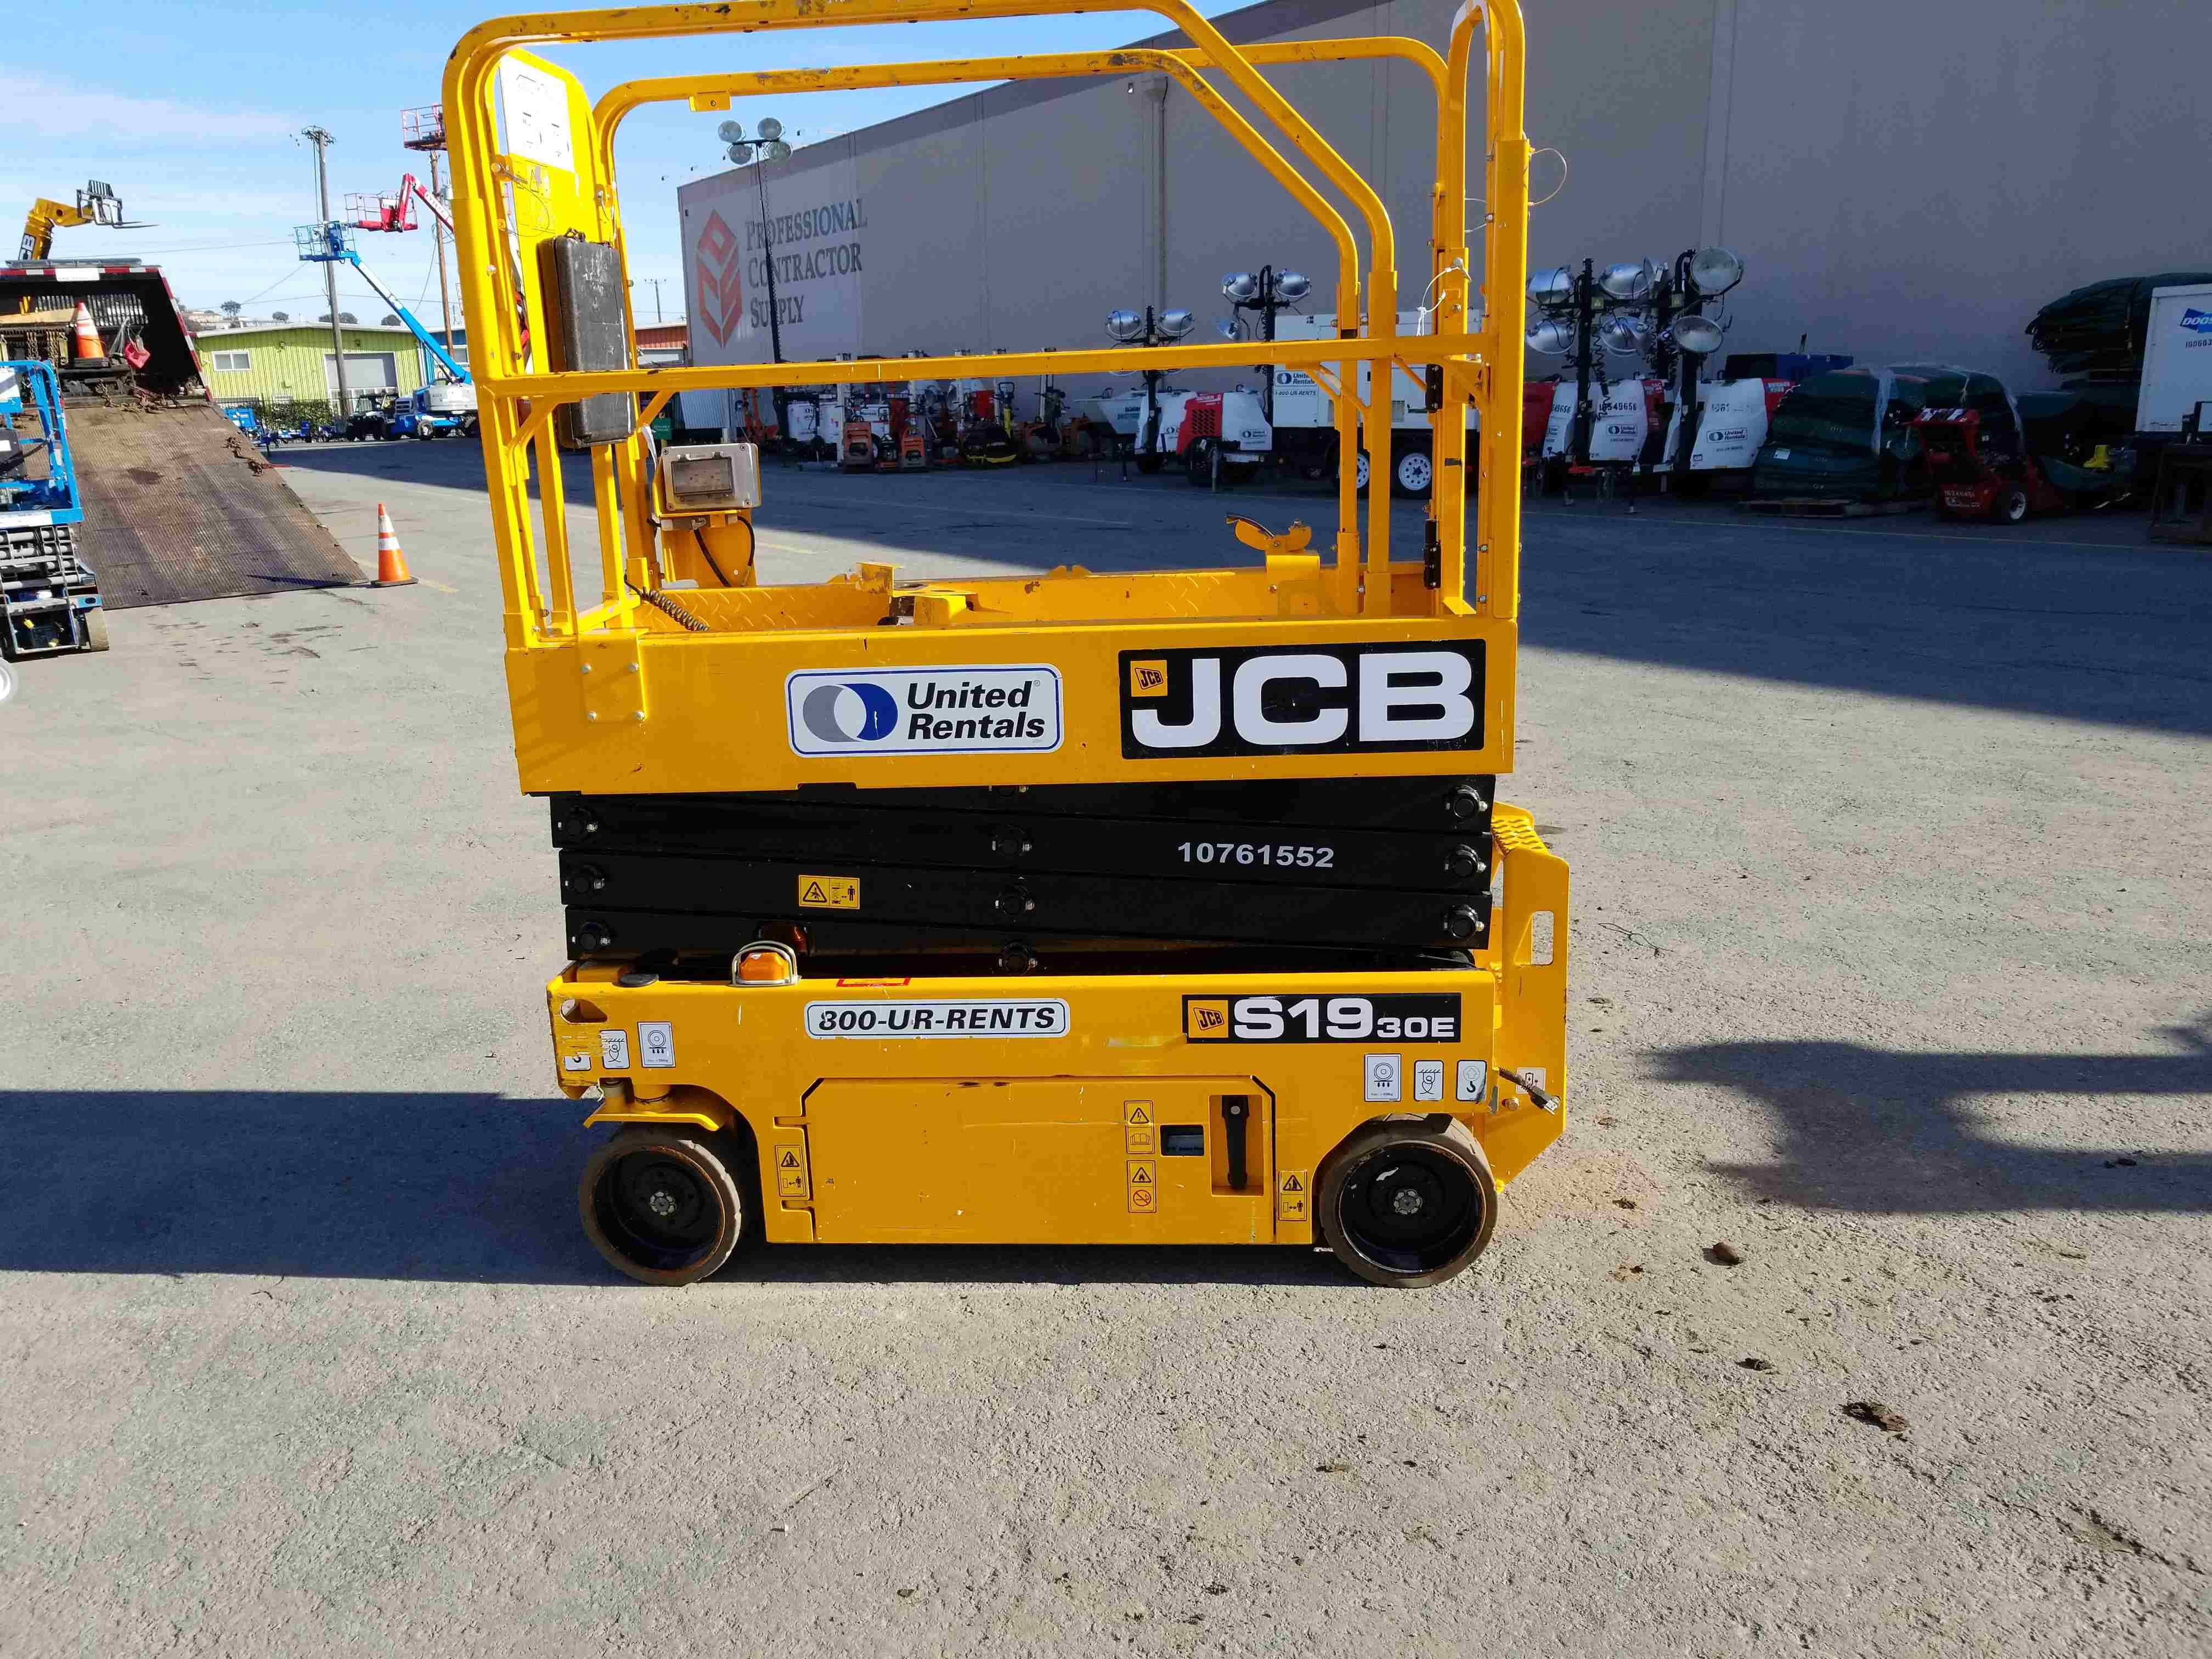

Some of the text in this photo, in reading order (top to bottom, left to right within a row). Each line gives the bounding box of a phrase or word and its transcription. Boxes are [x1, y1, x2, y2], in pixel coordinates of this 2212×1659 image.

[744, 198, 868, 251] PROFESSIONAL
[748, 242, 863, 289] CONTRACTOR
[751, 295, 804, 328] SUPLY
[1139, 670, 1163, 687] JCB
[907, 681, 1032, 710] United
[1132, 651, 1475, 748] JCB
[907, 712, 1046, 740] Rentals
[1178, 842, 1334, 867] 10761552
[819, 1007, 1055, 1031] 800-UR-RENTS
[1198, 1009, 1223, 1027] JCB
